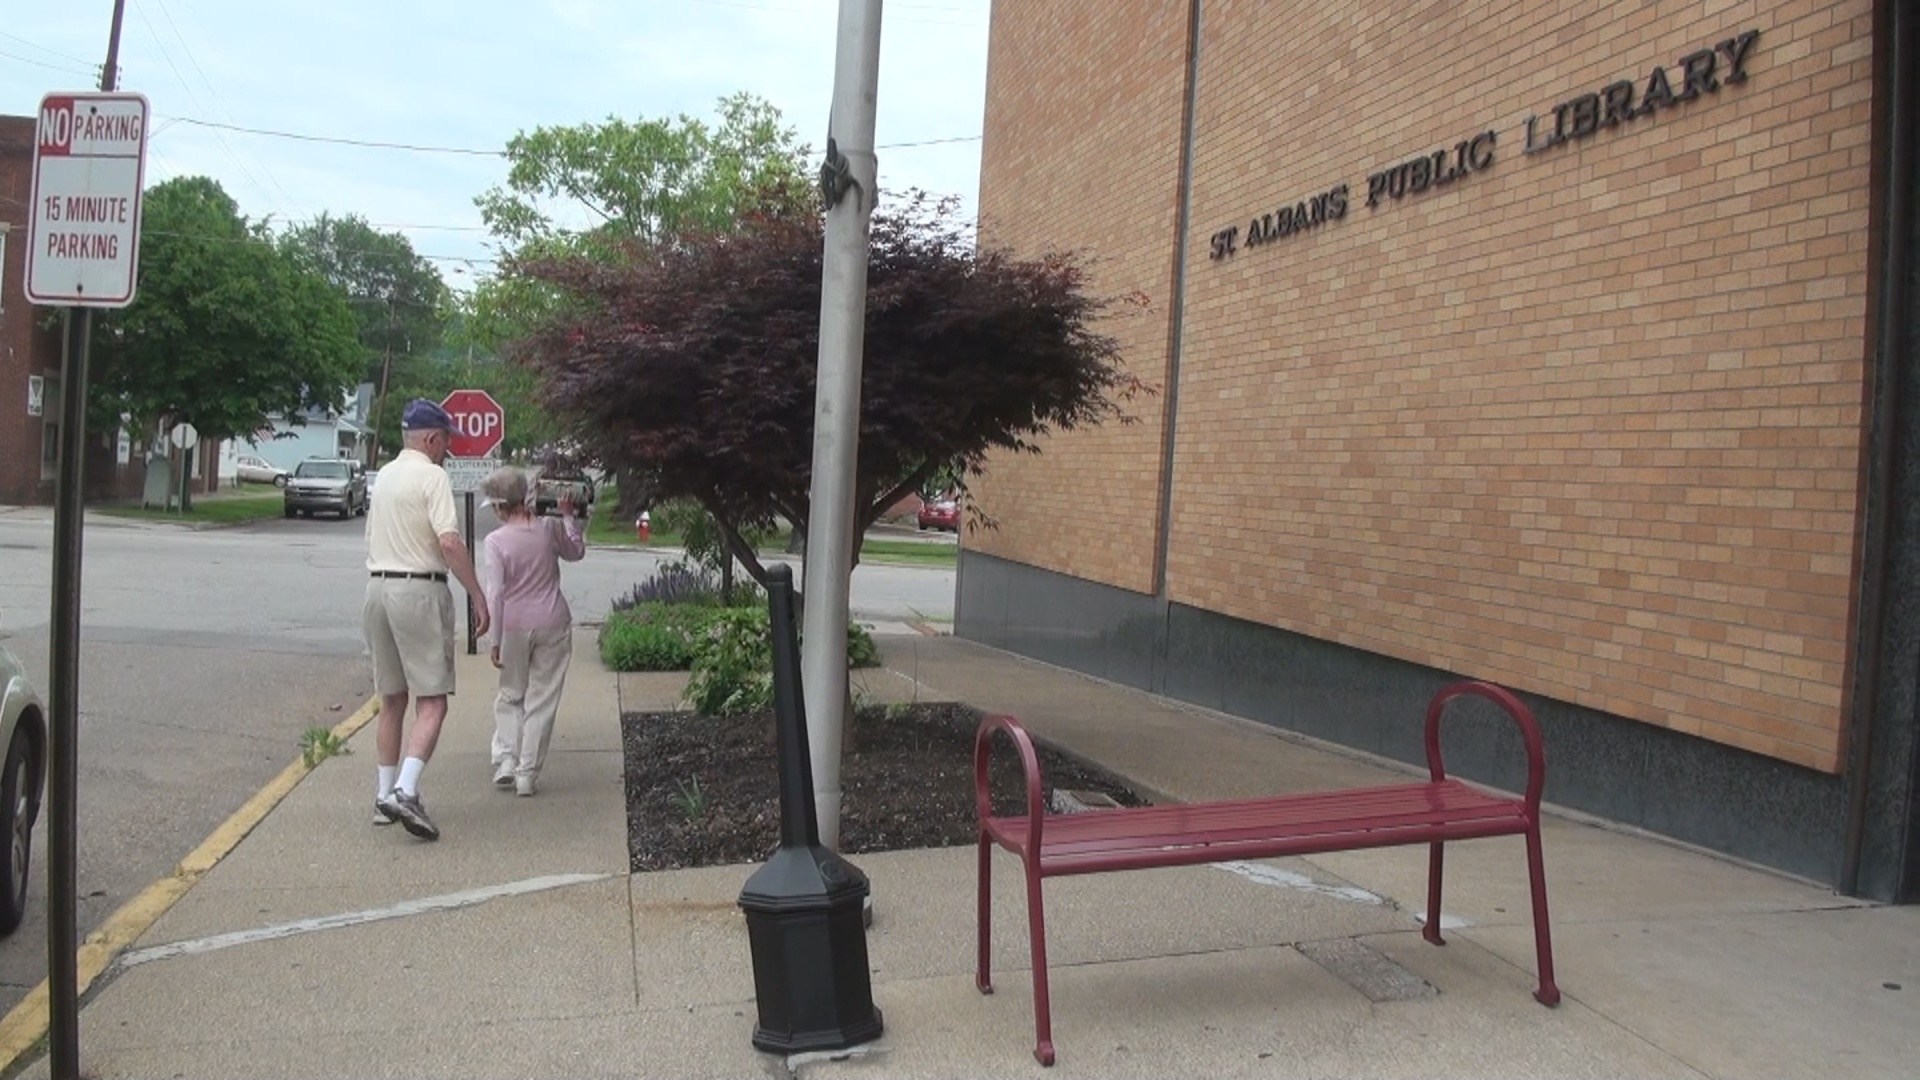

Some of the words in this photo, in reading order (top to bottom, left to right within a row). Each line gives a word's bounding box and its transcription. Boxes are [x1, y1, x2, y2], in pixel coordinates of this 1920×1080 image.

[41, 108, 68, 146] NO
[75, 115, 139, 141] PARKING
[1210, 226, 1237, 260] ST
[1244, 184, 1349, 249] ALBANS
[1365, 130, 1496, 208] PUBLIC
[1522, 29, 1759, 155] LIBRARY
[45, 196, 61, 221] 15
[66, 197, 127, 223] MINUTE
[48, 233, 118, 260] PARKING
[447, 412, 498, 437] TOP
